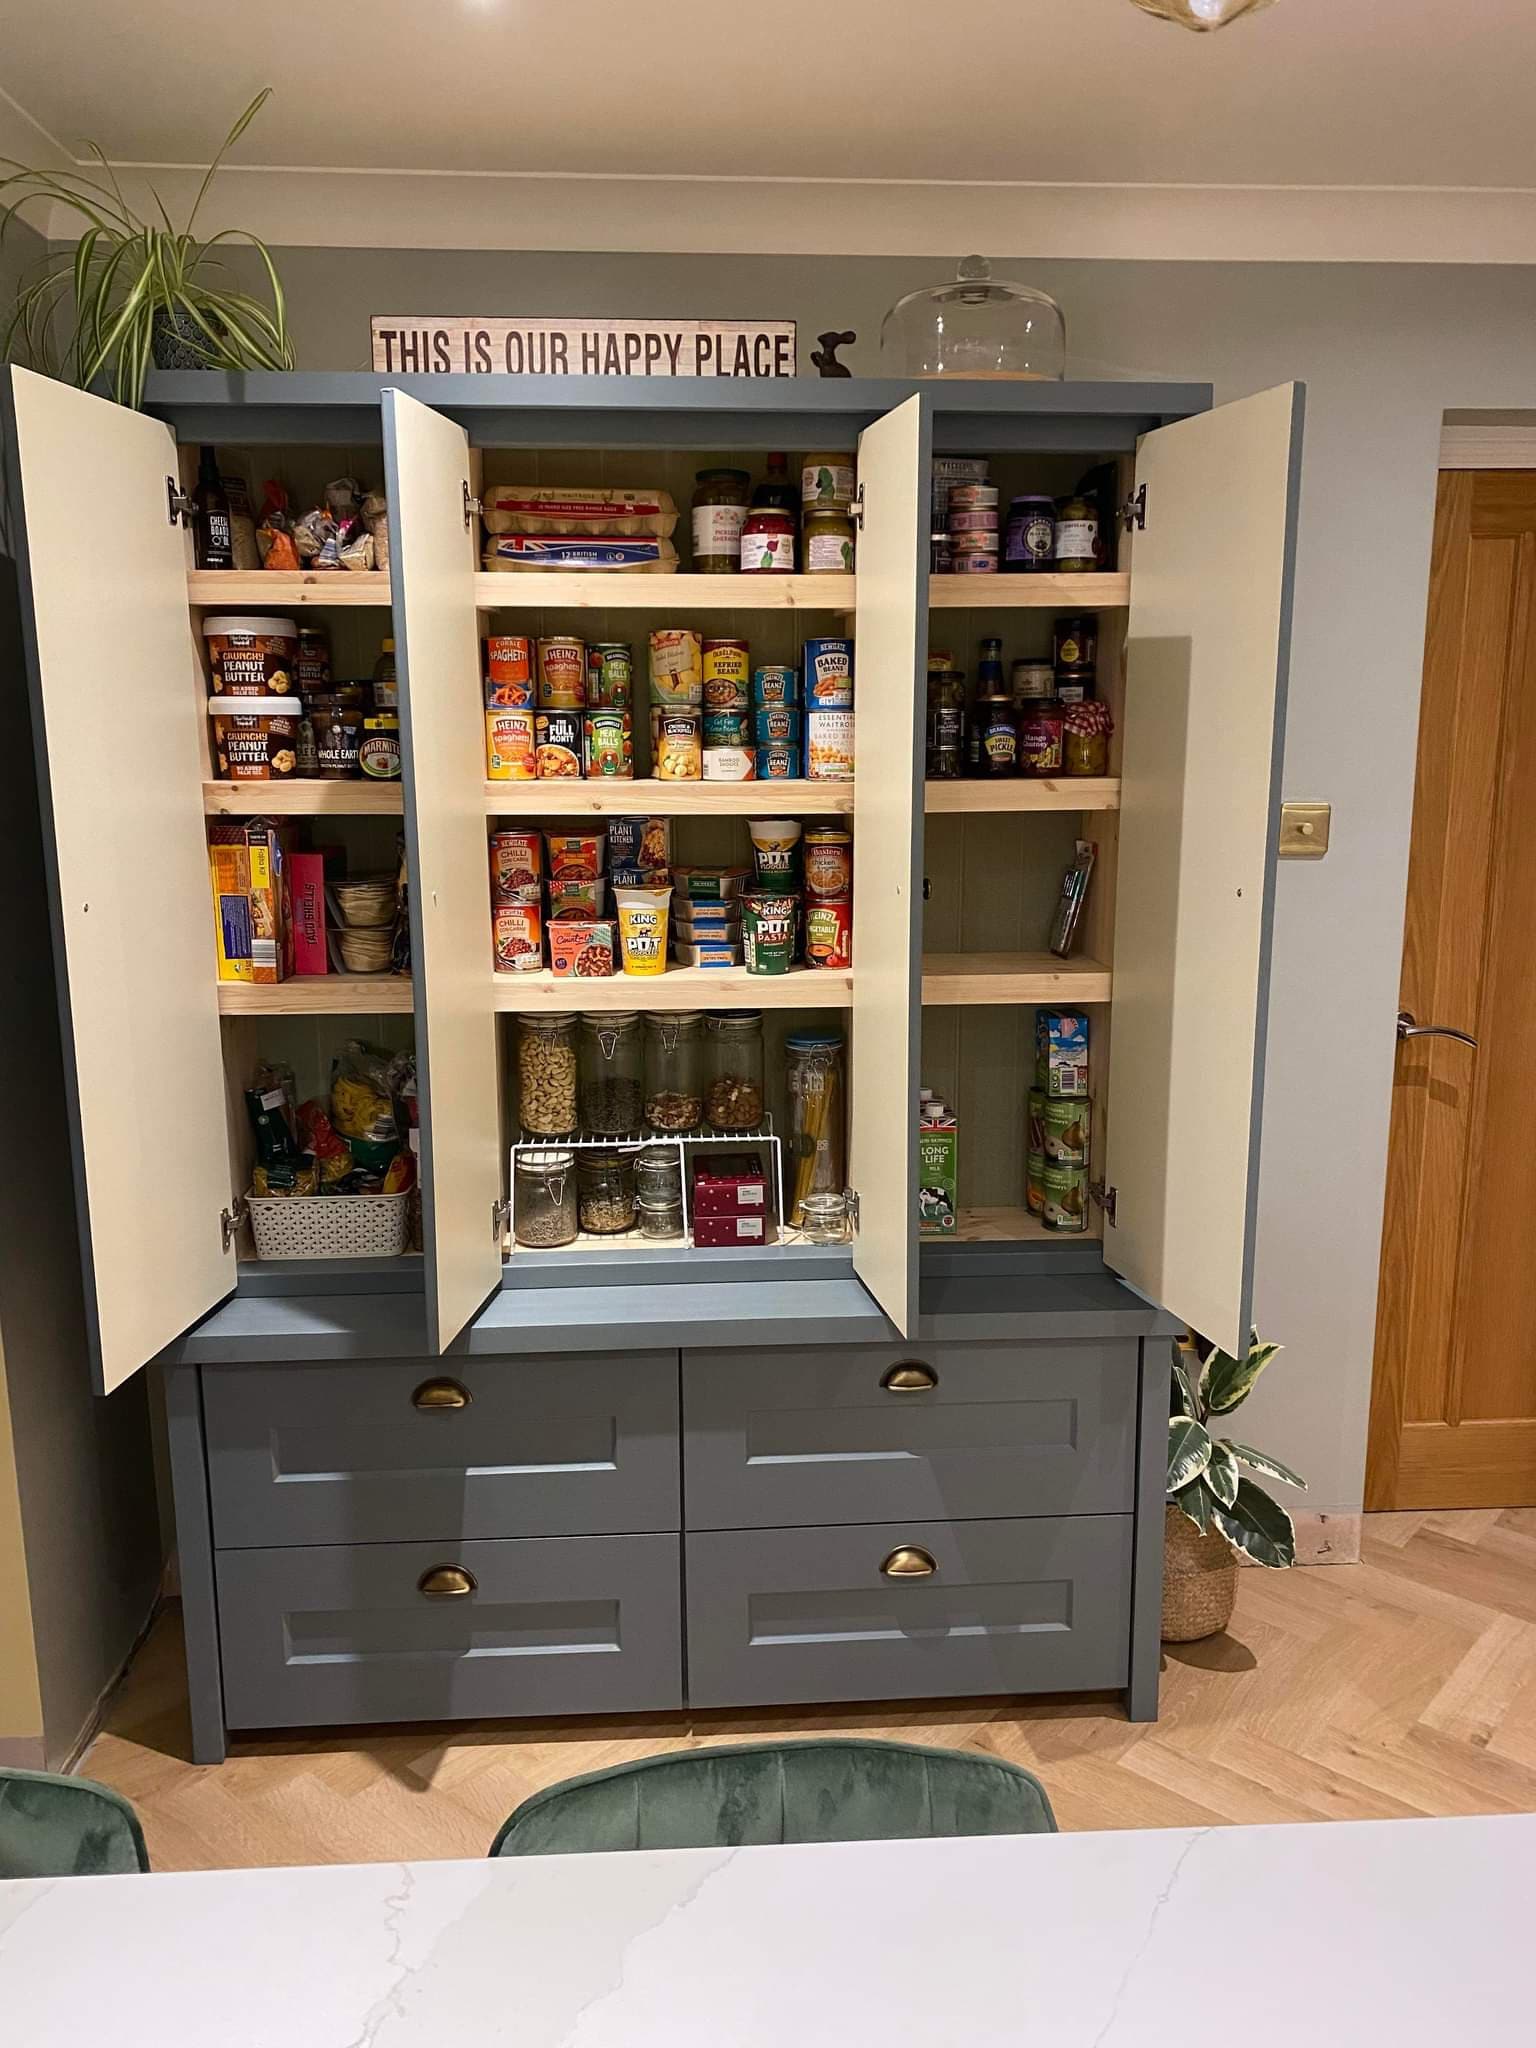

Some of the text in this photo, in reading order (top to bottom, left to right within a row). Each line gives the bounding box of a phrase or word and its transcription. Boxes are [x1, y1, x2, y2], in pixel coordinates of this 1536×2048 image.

[379, 331, 790, 377] THIS IS OUR HAPPY PLACE
[561, 551, 572, 560] 12
[223, 652, 265, 661] CRUNCHY
[490, 650, 528, 662] SPAGHETTI
[549, 649, 577, 660] HEINZ
[223, 661, 265, 671] PEANUT
[610, 662, 626, 670] MEAT
[817, 657, 848, 667] BAKED
[225, 671, 266, 682] BUTTER
[609, 670, 627, 679] BALLS
[498, 720, 526, 731] HEINZ
[550, 724, 574, 736] FULL
[227, 732, 268, 741] CRUNCHY
[494, 733, 529, 744] spaghetti
[600, 729, 617, 738] MEAT
[228, 741, 269, 751] PEANUT
[364, 739, 402, 754] MARMITE
[598, 737, 619, 746] BALLS
[991, 743, 1014, 752] PICKLE
[230, 751, 270, 762] BUTTER
[318, 749, 340, 760] WHOLE
[609, 825, 633, 836] PLANT
[610, 836, 634, 844] KITCHEN
[501, 849, 527, 858] CHILLI
[757, 851, 792, 865] POT
[613, 875, 637, 885] PLANT
[304, 883, 317, 945] TACO SHELLS
[763, 907, 787, 916] KING
[808, 911, 833, 921] HEINZ
[499, 919, 524, 927] CHILLI
[630, 914, 657, 925] KING
[756, 919, 791, 934] POT
[758, 934, 788, 942] PASTA
[627, 937, 662, 951] POT
[921, 1146, 949, 1155] LONG
[925, 1154, 945, 1163] LIFE
